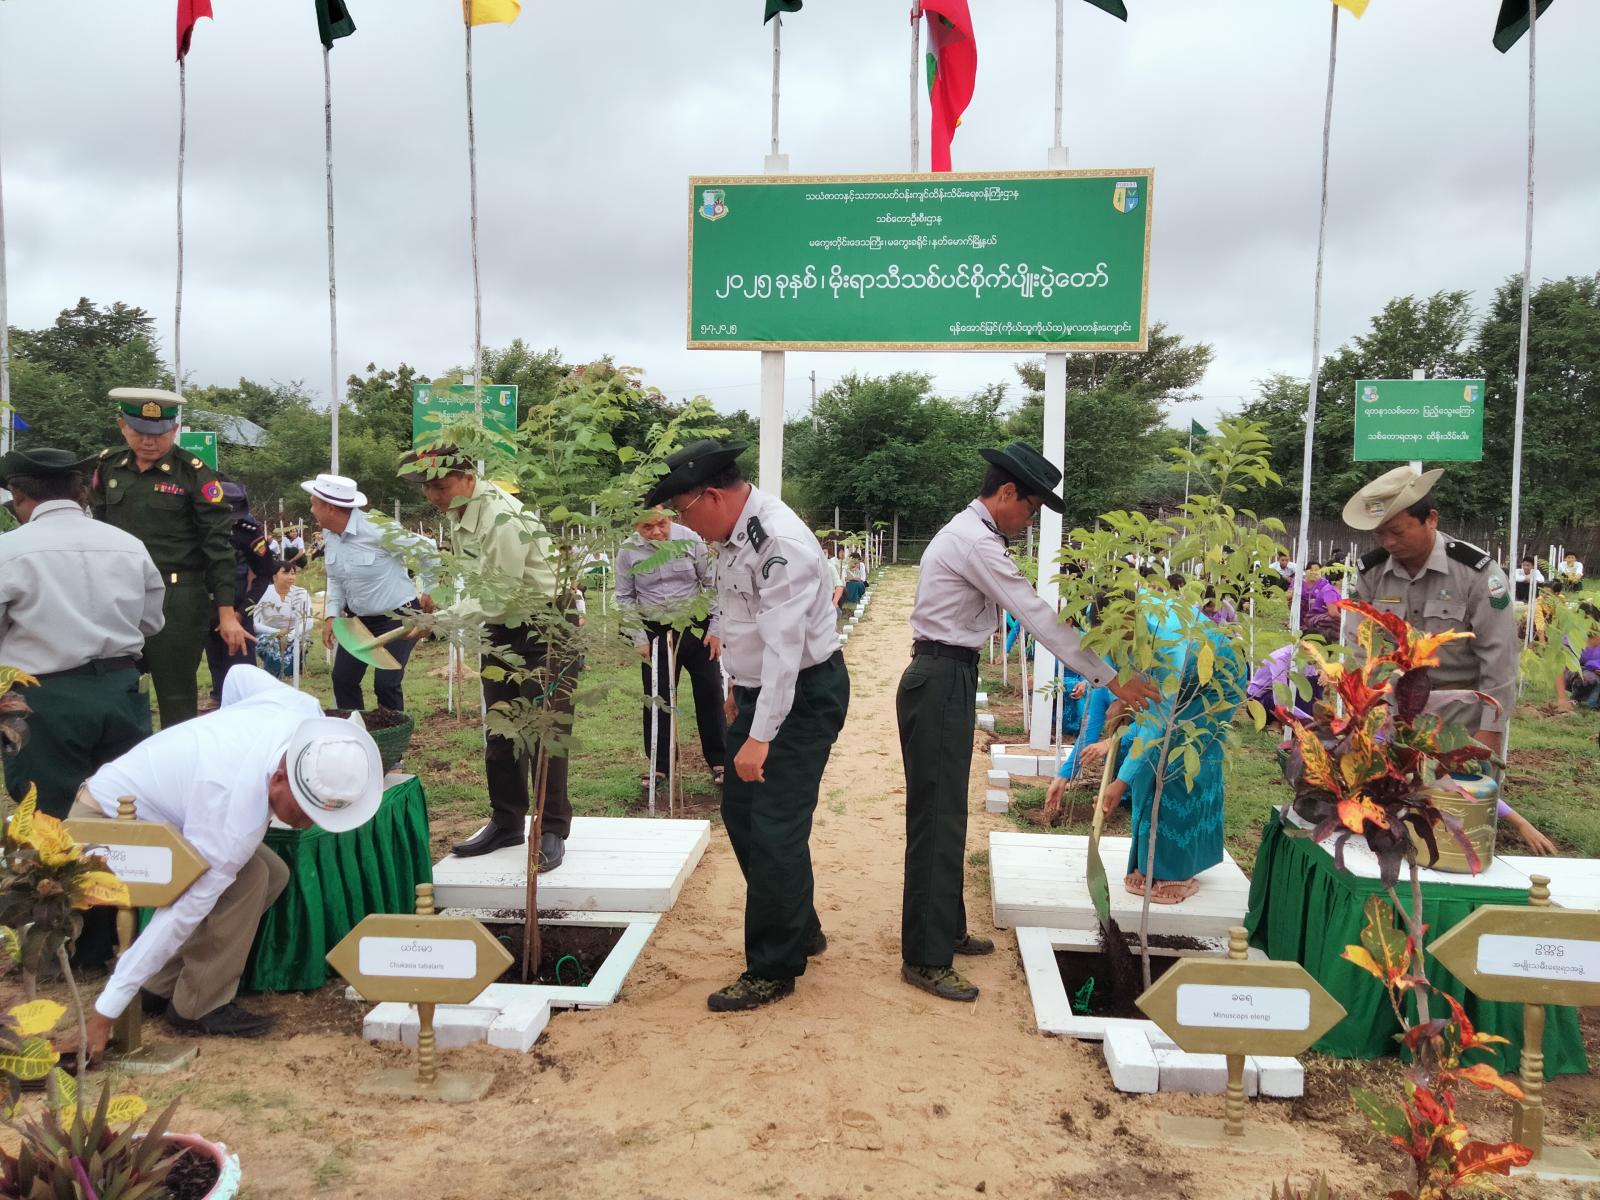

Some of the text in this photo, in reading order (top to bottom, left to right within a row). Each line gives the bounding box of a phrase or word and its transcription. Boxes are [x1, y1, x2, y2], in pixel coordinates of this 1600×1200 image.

[875, 212, 943, 227] သစ်တောဦးစီးဌာန
